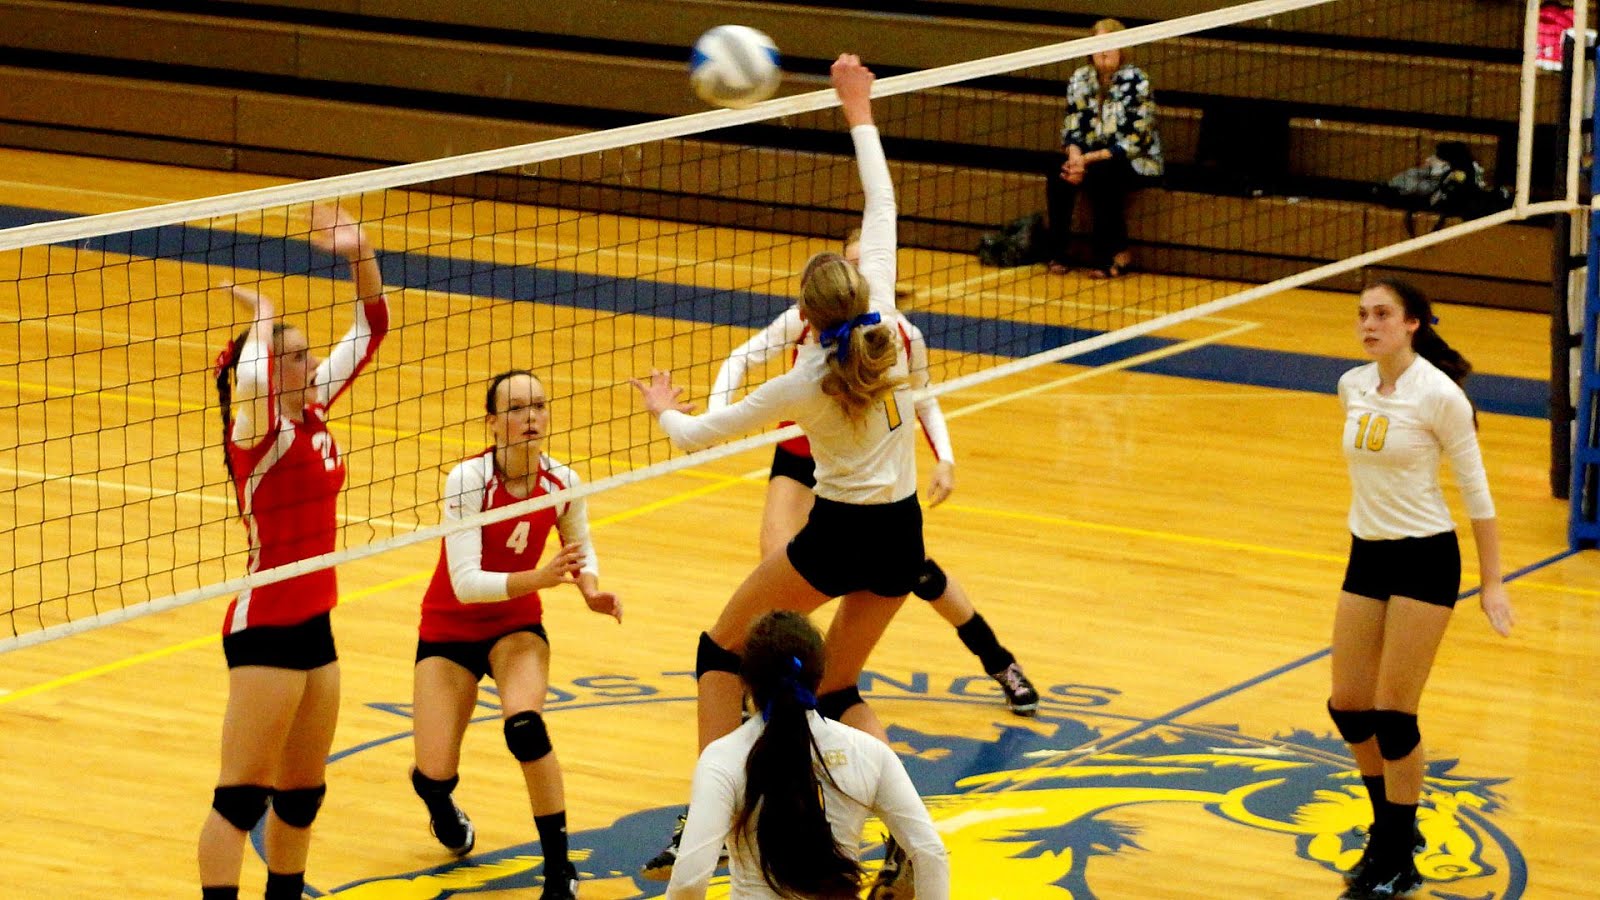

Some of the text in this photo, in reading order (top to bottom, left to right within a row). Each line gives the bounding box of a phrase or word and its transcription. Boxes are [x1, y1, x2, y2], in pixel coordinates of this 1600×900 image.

[311, 430, 342, 472] 2
[1354, 412, 1390, 452] 10
[505, 520, 531, 555] 4
[363, 669, 1122, 718] USNGS
